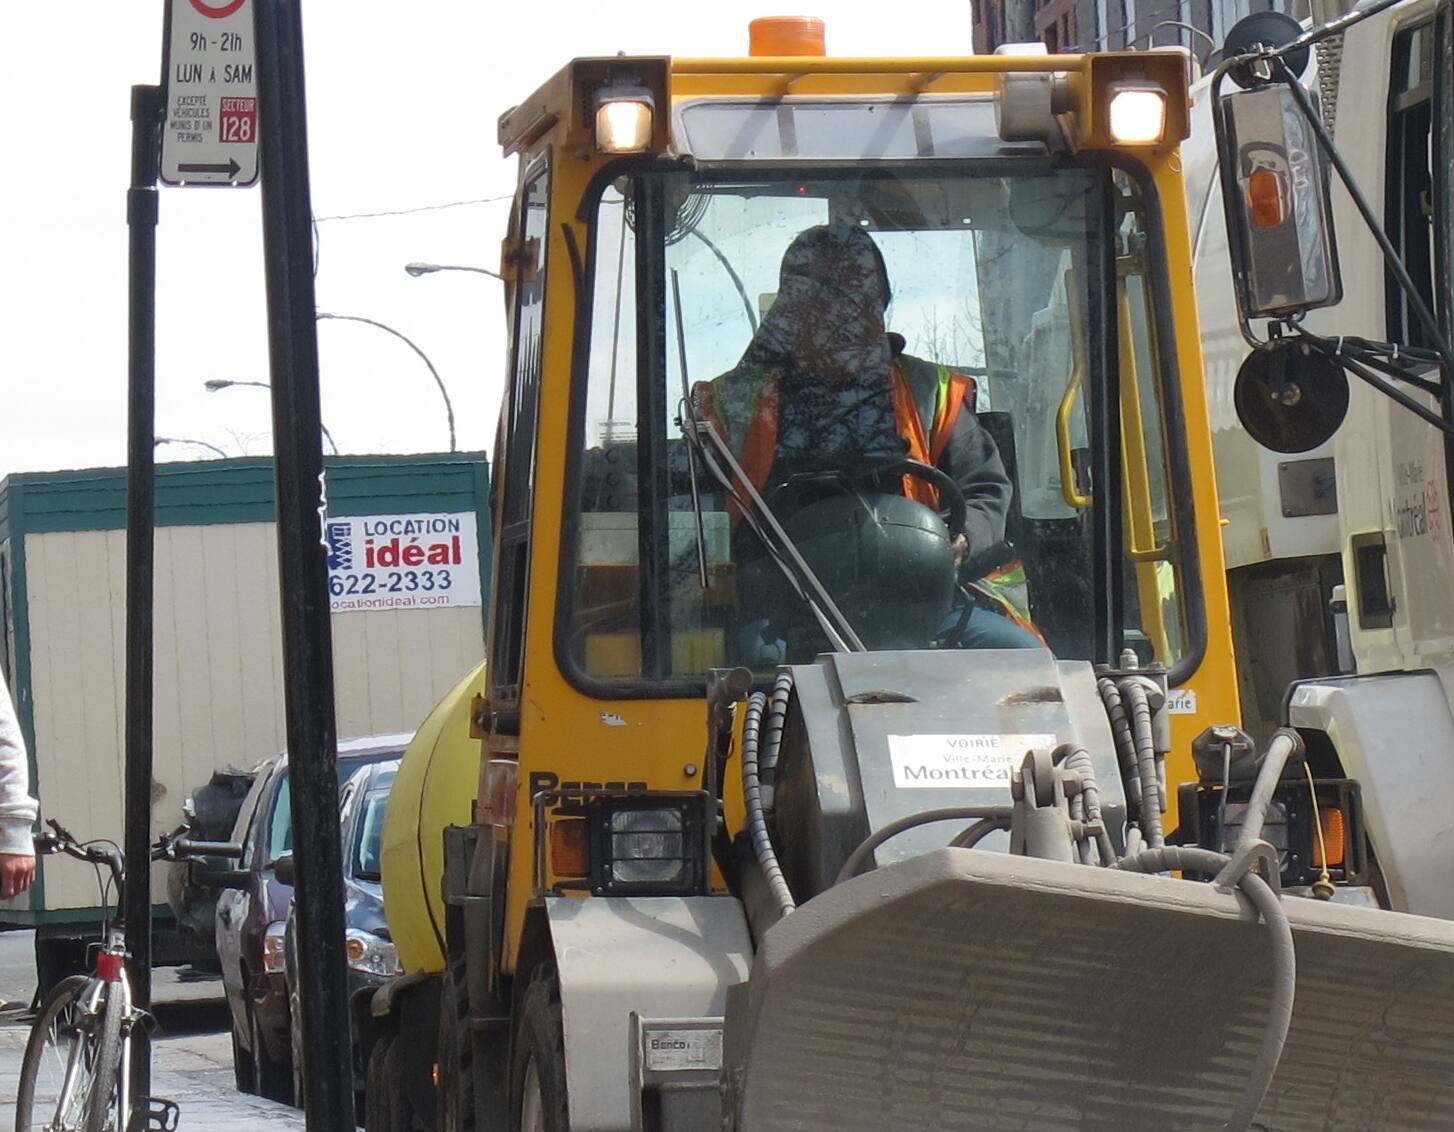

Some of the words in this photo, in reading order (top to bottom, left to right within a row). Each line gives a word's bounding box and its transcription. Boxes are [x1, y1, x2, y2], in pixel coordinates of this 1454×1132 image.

[190, 32, 206, 51] 9h
[220, 32, 242, 51] 21h
[176, 64, 202, 83] LUN
[223, 64, 252, 83] SAM
[222, 99, 254, 111] SECTEUR
[177, 132, 203, 142] PERMIS
[222, 116, 251, 141] 128
[364, 518, 460, 537] LOCATION
[365, 535, 461, 568] idéal
[329, 569, 452, 596] 622-2333
[947, 738, 1001, 748] VOIRIE
[943, 754, 1013, 764] Ville-Marie
